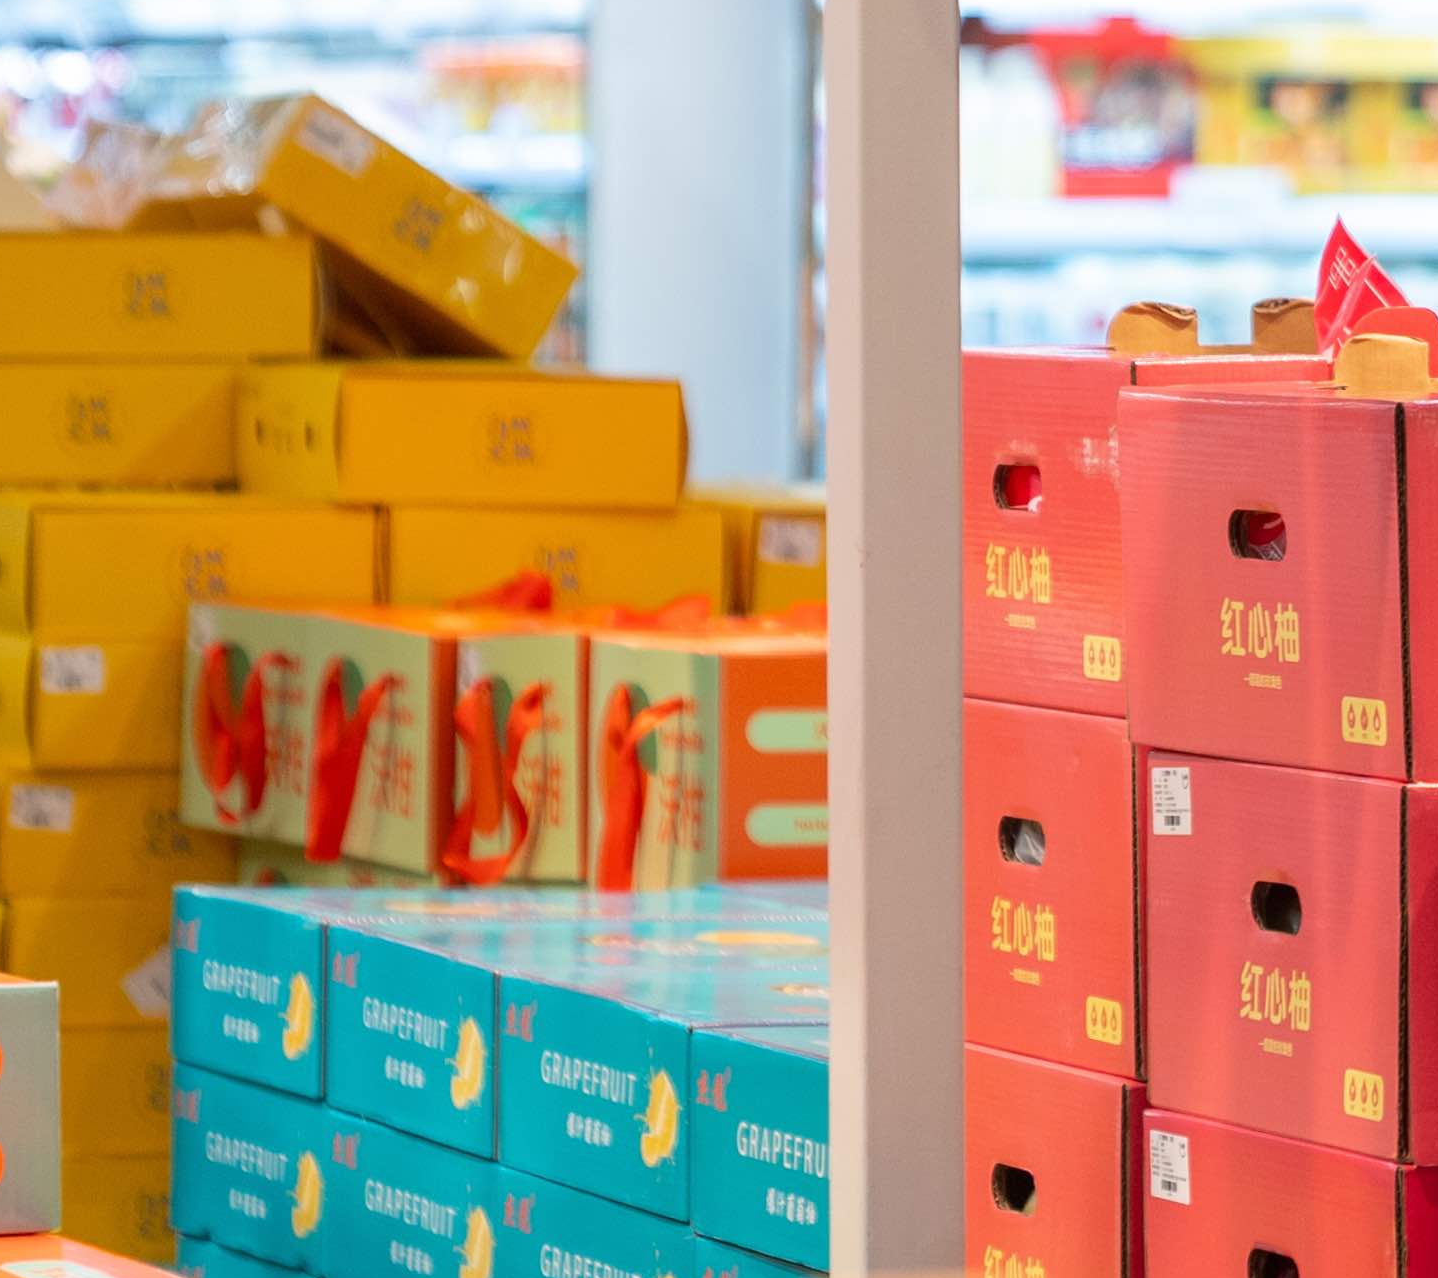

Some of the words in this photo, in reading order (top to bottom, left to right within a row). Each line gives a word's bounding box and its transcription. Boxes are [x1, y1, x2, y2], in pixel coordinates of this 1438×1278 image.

[986, 543, 1052, 605] 红心柚
[1220, 597, 1300, 663] 红心柚
[990, 895, 1056, 962] 红心柚
[202, 958, 281, 1005] GRAPEFRUIT
[1240, 961, 1312, 1032] 红心柚
[363, 996, 449, 1051] GRAPEFRUIT
[540, 1049, 637, 1106] GRAPEFRUIT
[205, 1130, 289, 1182] GRAPEFRUIT
[736, 1121, 829, 1178] GRAPEFRU
[365, 1178, 458, 1238] GRAPEFRUIT
